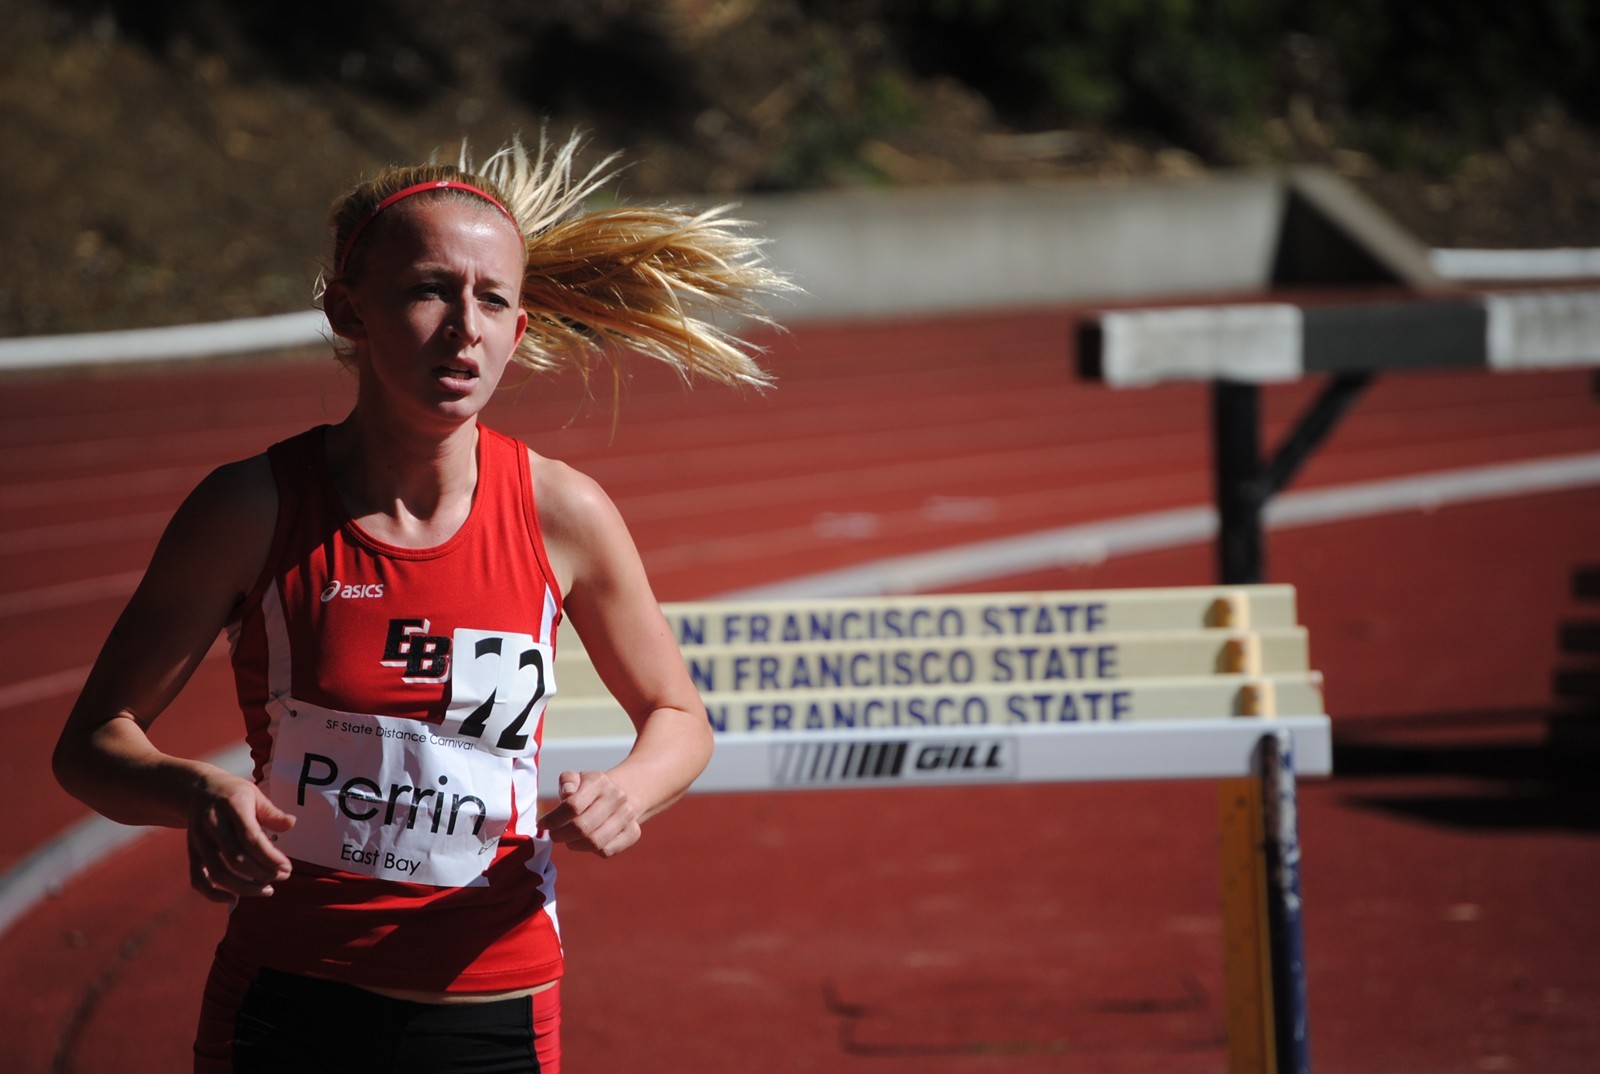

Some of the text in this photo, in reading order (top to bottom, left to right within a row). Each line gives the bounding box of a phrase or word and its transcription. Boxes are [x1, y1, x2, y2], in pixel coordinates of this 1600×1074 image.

[341, 584, 384, 599] asics
[723, 608, 966, 644] FRANCISCO
[981, 603, 1107, 636] STATE
[380, 618, 453, 684] EB
[733, 649, 976, 692] FRANCISCO
[991, 644, 1119, 683] STATE
[326, 719, 339, 730] SF
[341, 722, 373, 735] State
[375, 726, 427, 743] Distance
[745, 696, 989, 732] FRANCISCO
[1006, 690, 1132, 724] STATE
[916, 744, 1003, 770] GILL
[297, 752, 487, 836] Perrin
[341, 844, 421, 876] East Bay
